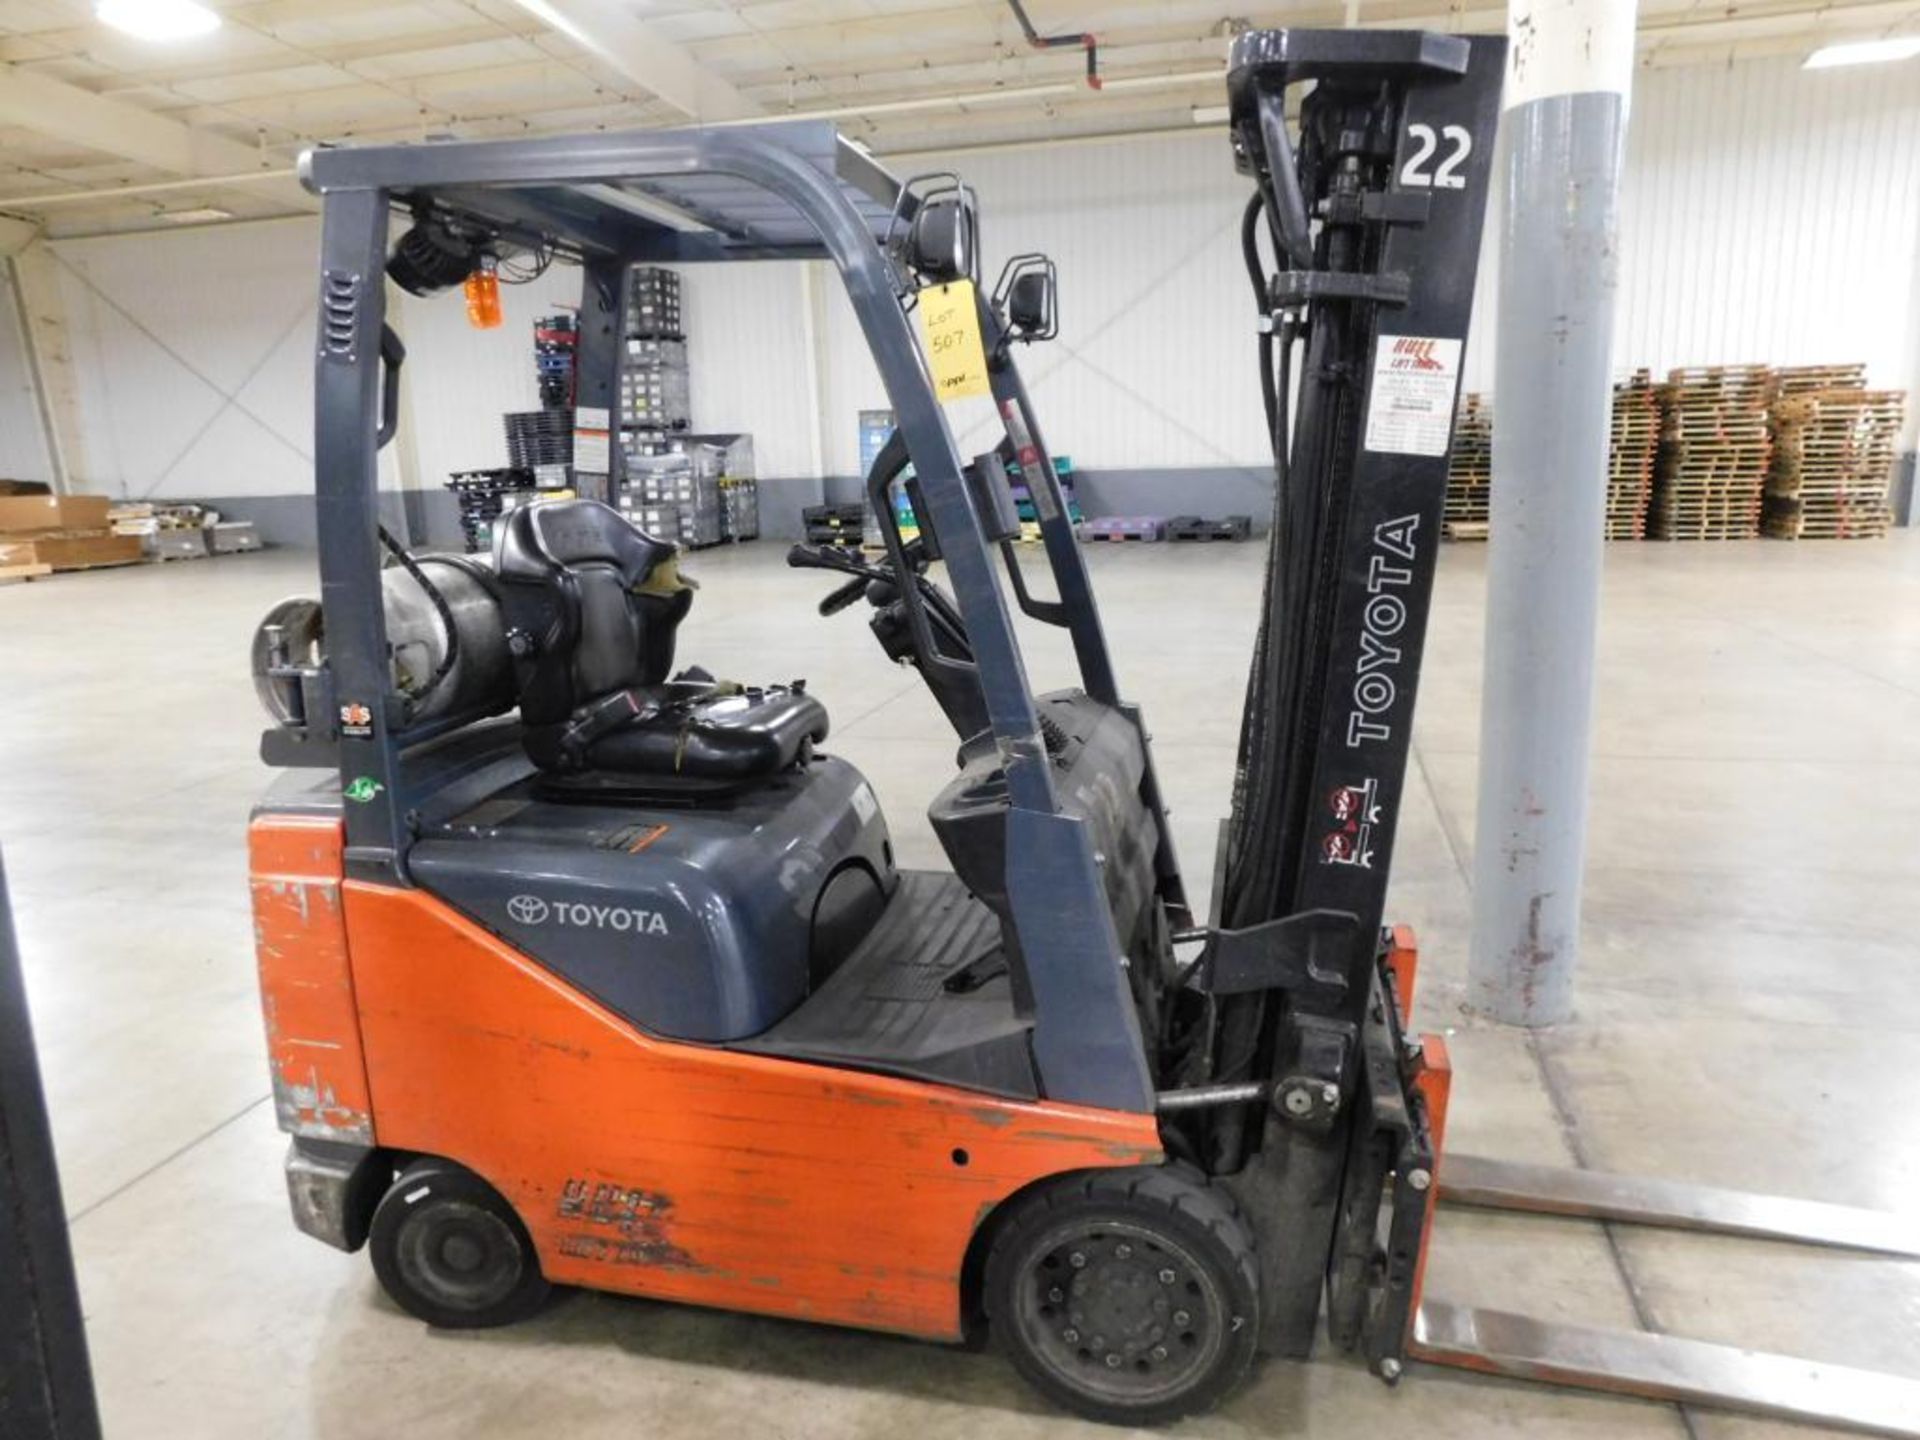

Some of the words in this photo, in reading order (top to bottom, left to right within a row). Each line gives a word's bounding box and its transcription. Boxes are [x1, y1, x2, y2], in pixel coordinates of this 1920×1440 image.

[1400, 122, 1472, 190] 22
[928, 307, 956, 327] LOT
[933, 329, 964, 354] 507
[1347, 513, 1421, 748] TOYOTA
[553, 901, 668, 936] TOYOTA
